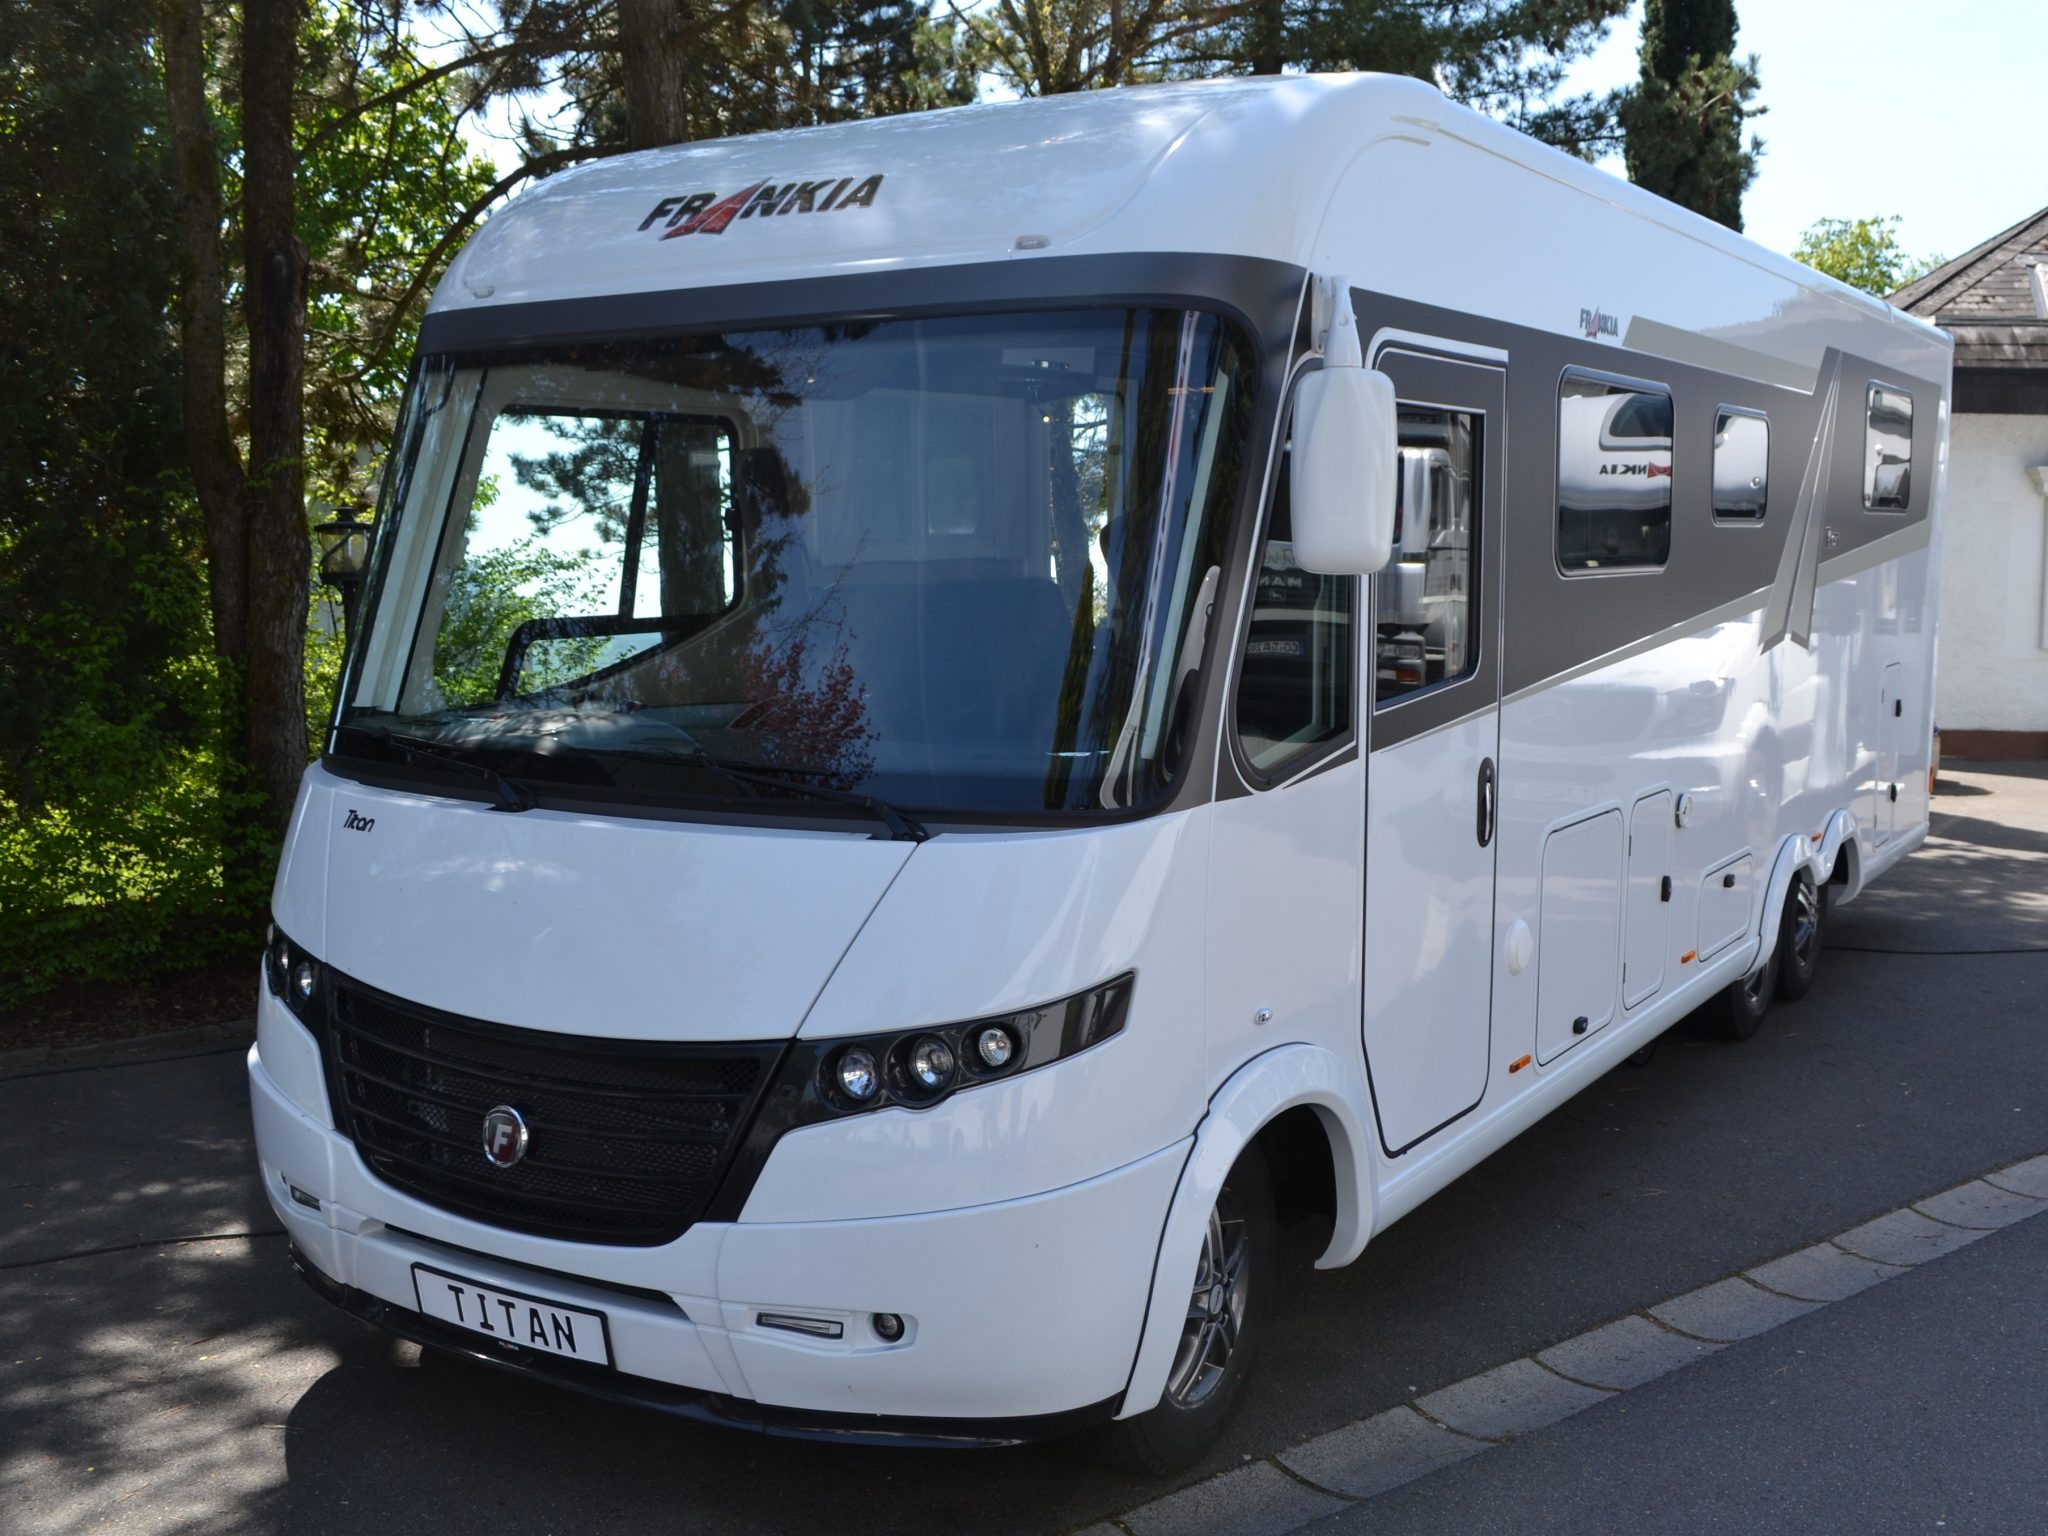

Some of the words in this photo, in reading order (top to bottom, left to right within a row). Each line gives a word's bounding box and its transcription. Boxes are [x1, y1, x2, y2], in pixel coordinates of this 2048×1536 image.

[637, 173, 885, 241] FRANKIA
[1580, 306, 1619, 339] FRANKIA
[343, 809, 375, 832] Titan
[447, 1284, 577, 1353] TITAN
